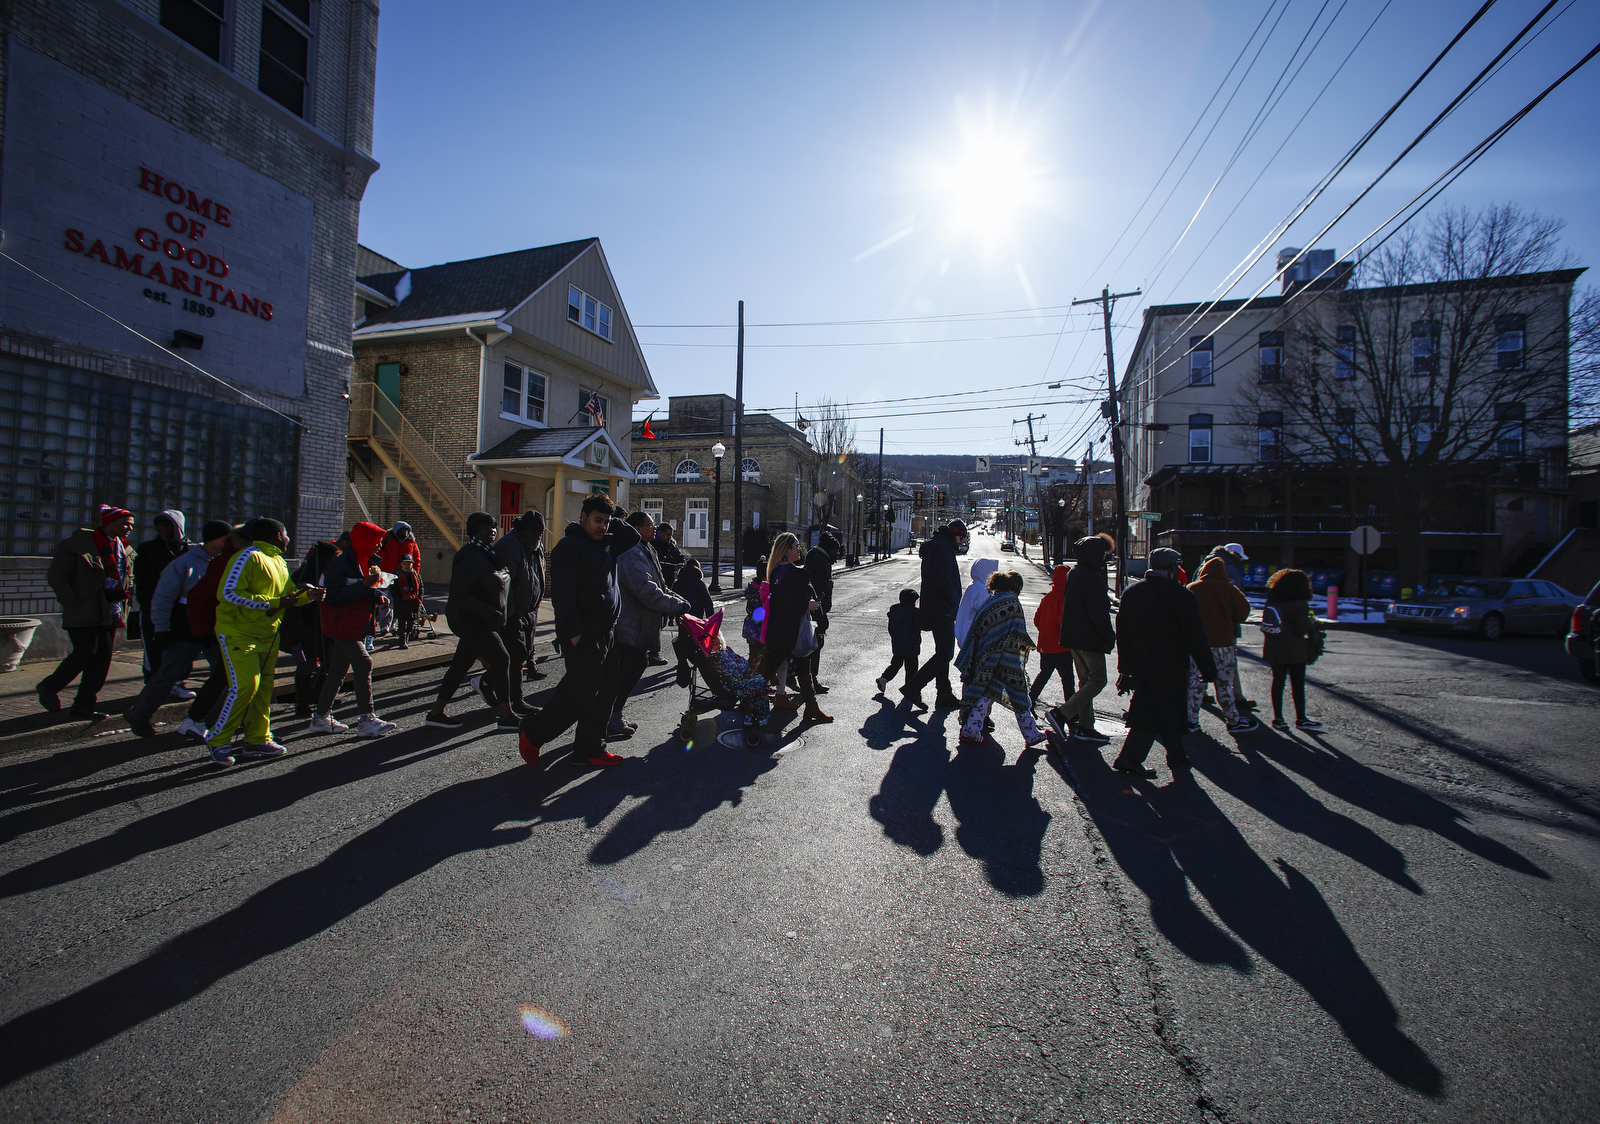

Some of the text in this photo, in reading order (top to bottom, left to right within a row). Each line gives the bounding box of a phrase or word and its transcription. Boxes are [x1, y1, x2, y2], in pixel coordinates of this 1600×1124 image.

[138, 166, 232, 227] HOME
[166, 212, 206, 240] OF
[65, 228, 273, 321] SAMARITANS
[135, 228, 229, 277] GOOD
[143, 288, 215, 318] est. 1889
